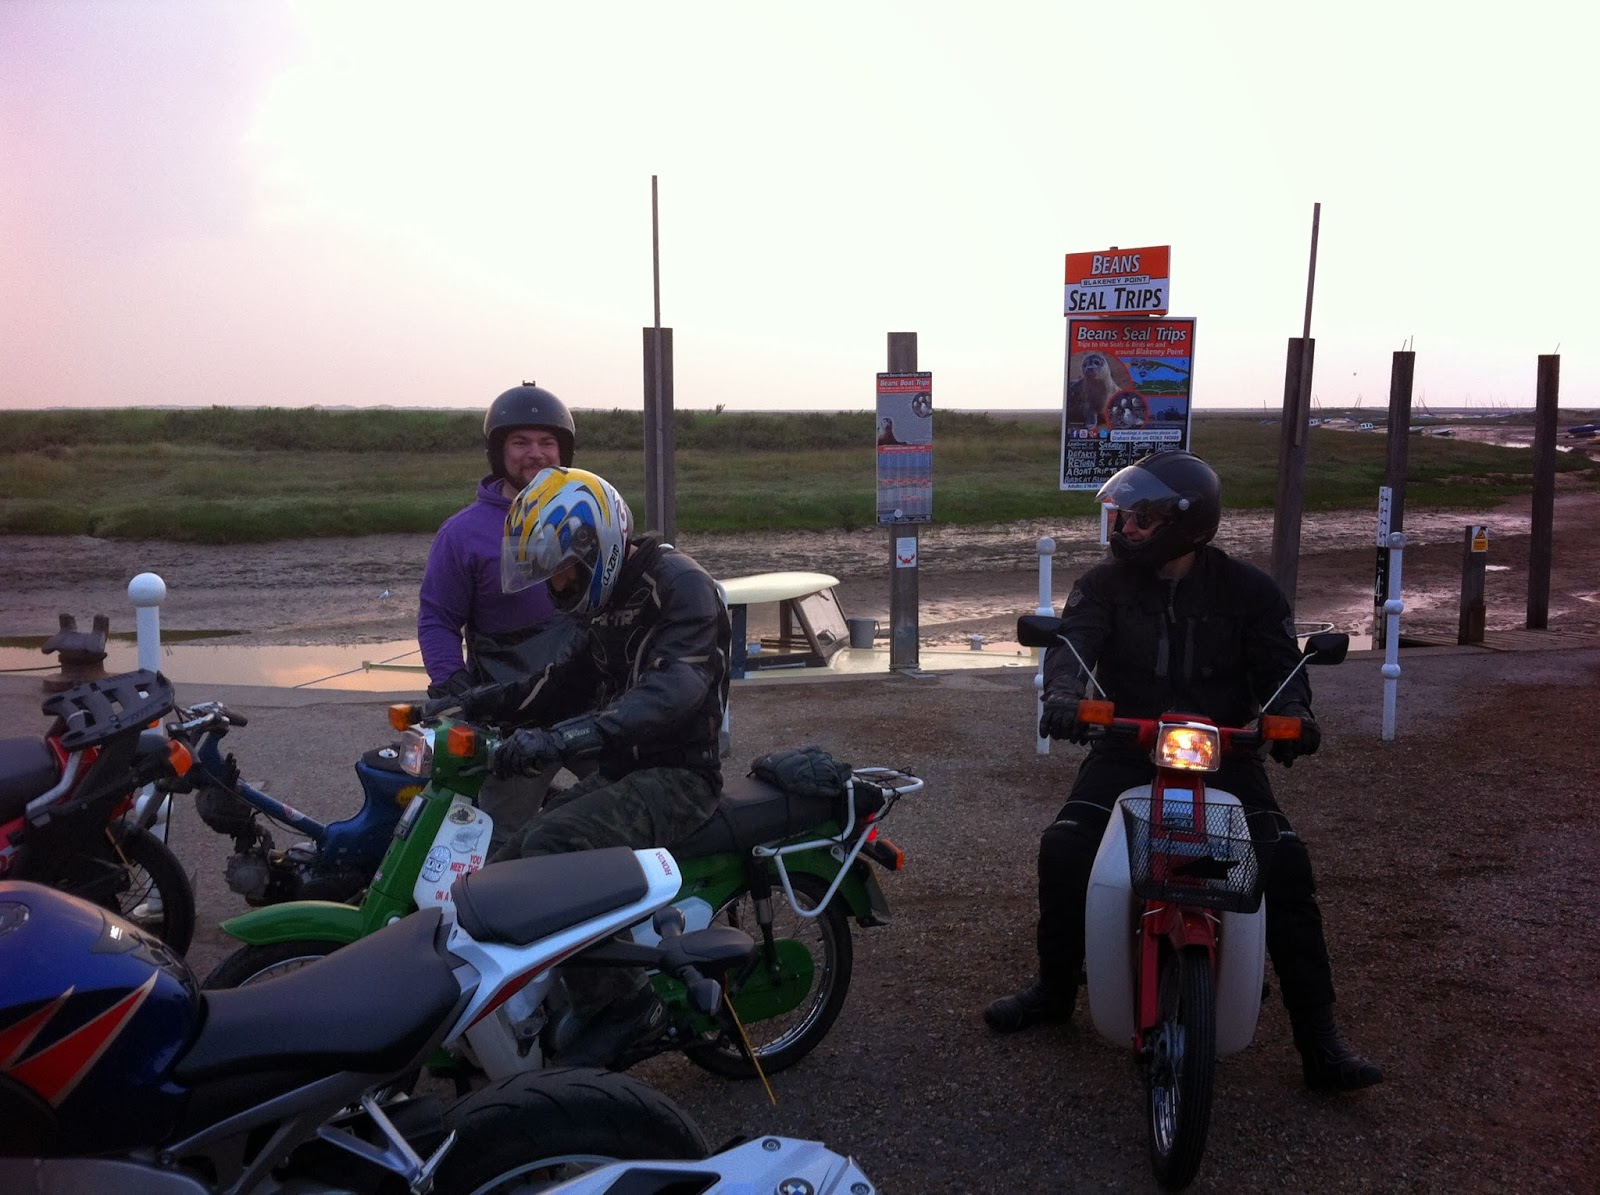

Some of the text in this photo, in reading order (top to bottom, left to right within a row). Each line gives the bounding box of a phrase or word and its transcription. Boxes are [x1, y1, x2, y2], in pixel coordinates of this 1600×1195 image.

[1091, 254, 1140, 275] BEANS
[1083, 278, 1120, 286] BLAKENEY
[1068, 287, 1162, 311] SEAL TRIPS
[1077, 326, 1186, 344] Beans Seal Trips
[1135, 348, 1165, 356] Blakeney
[916, 379, 930, 387] Trips
[1067, 458, 1096, 467] RETURN
[1073, 467, 1092, 476] BOAT
[1093, 466, 1109, 475] TRIP
[603, 543, 619, 586] LAZER
[470, 854, 482, 864] YOU
[655, 851, 672, 876] HONDA
[450, 861, 466, 872] MEET
[435, 890, 444, 901] ON
[444, 891, 450, 901] A
